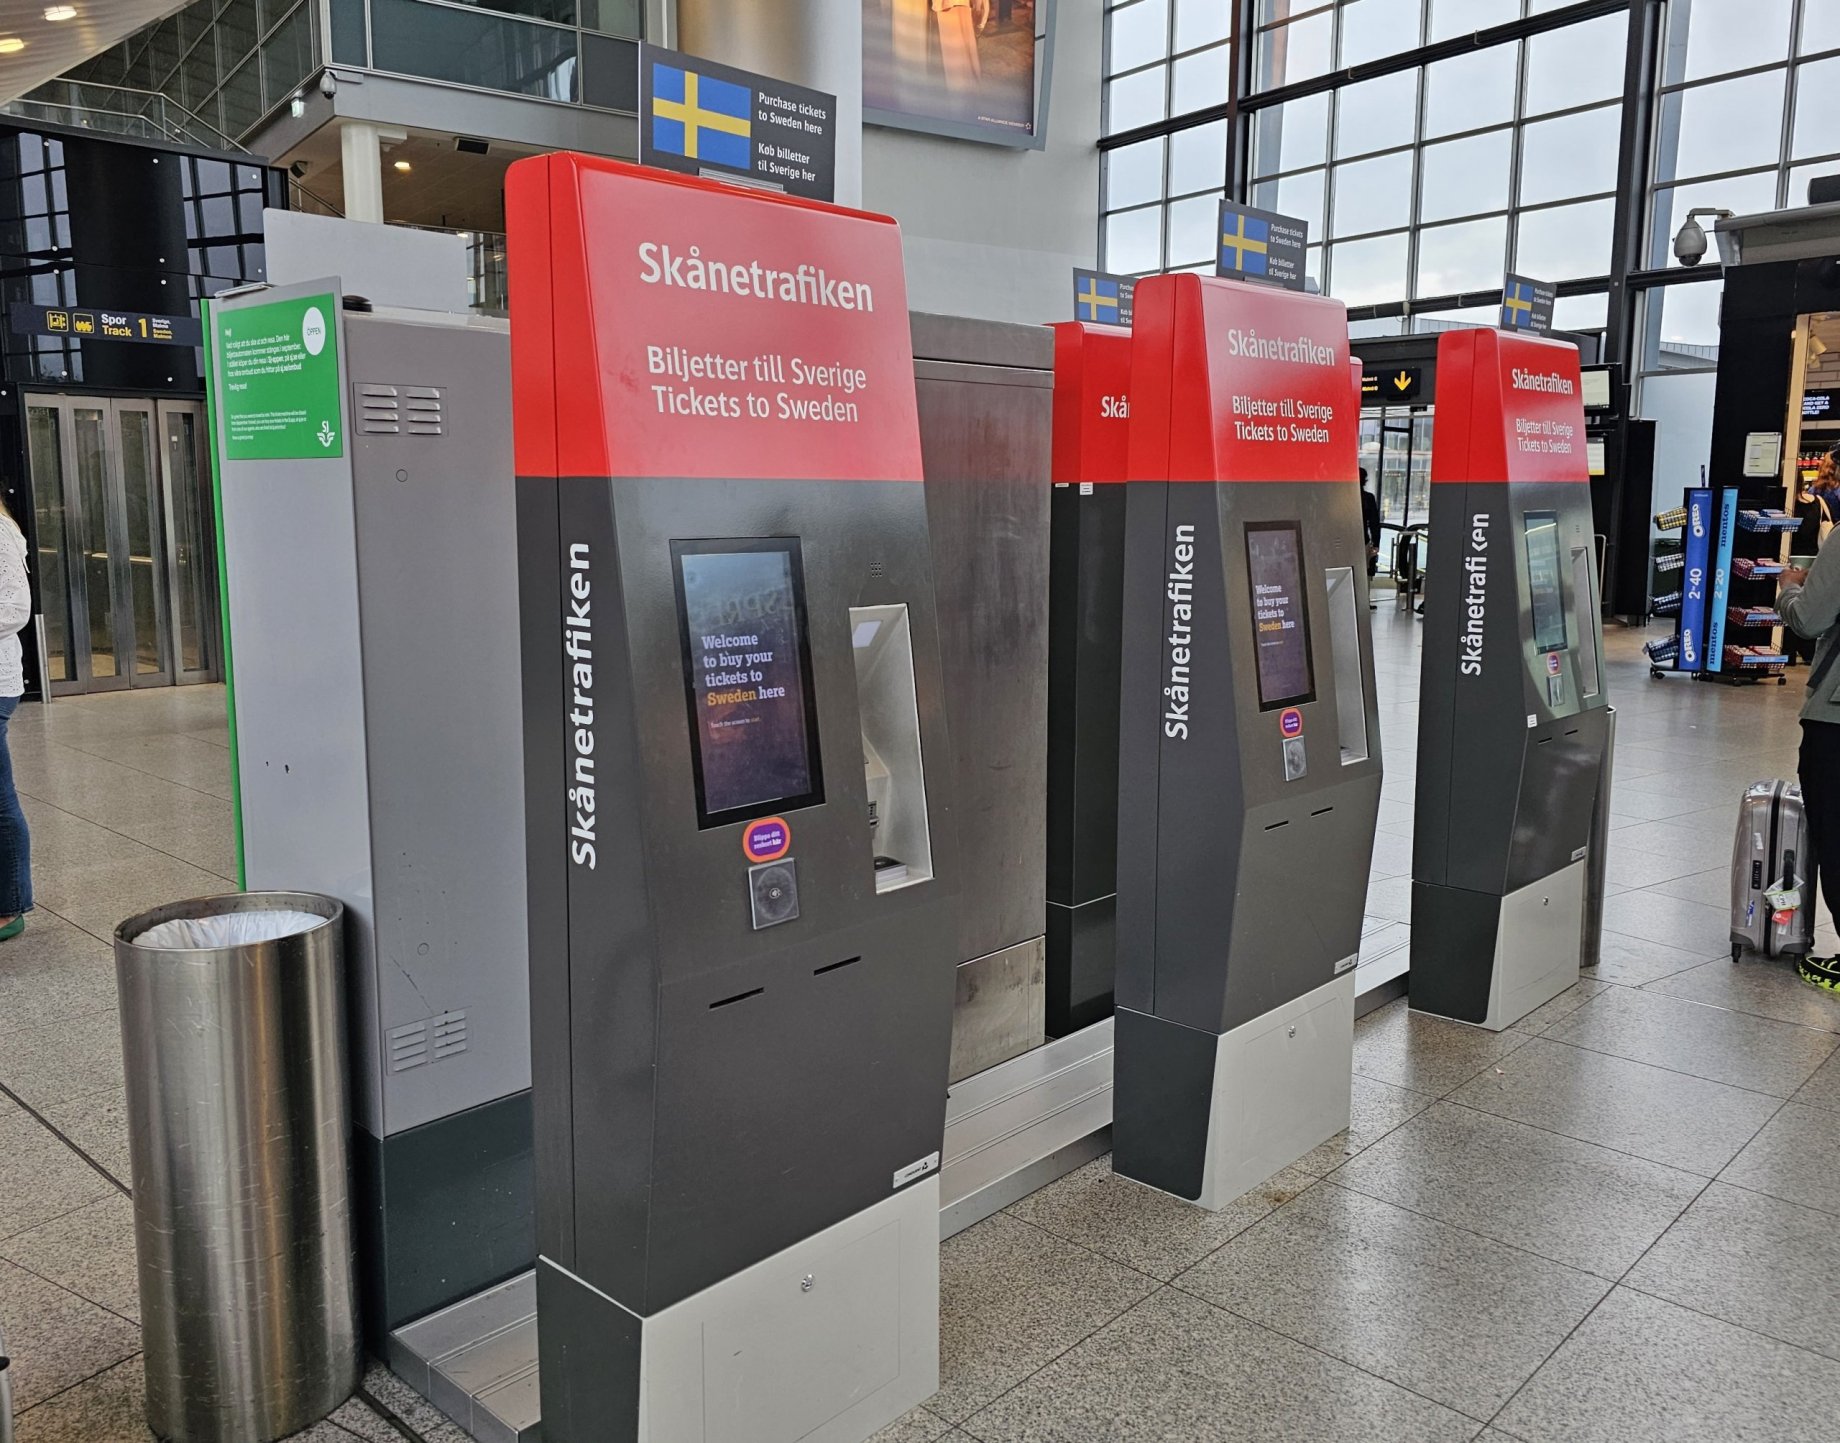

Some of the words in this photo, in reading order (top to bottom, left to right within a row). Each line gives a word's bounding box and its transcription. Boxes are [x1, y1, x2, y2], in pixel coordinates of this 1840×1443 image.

[759, 92, 796, 111] Purchase
[799, 104, 826, 119] tickets
[758, 110, 767, 120] to
[770, 112, 802, 130] Sweden
[805, 120, 822, 134] here
[759, 142, 774, 156] Køb
[777, 146, 810, 164] billetter
[758, 160, 767, 171] til
[770, 162, 800, 179] Sverige
[802, 169, 816, 181] her
[638, 242, 873, 312] Skånetrafiken
[101, 314, 126, 325] Spor
[138, 318, 148, 338] 1
[102, 326, 132, 337] Track
[1228, 328, 1335, 366] Skånetrafiken
[647, 345, 748, 382] Biljetter
[753, 354, 785, 383] till
[791, 358, 867, 393] Sverige
[1512, 368, 1573, 395] Skånetrafiken
[652, 385, 740, 418] Tickets
[747, 392, 769, 418] to
[777, 392, 858, 422] Sweden
[1100, 395, 1130, 418] Skå
[1232, 396, 1277, 419] Biljetter
[1280, 398, 1294, 418] till
[1297, 400, 1333, 423] Sverige
[1234, 421, 1274, 441] Tickets
[1277, 424, 1288, 441] to
[1290, 423, 1329, 443] Sweden
[1516, 418, 1541, 436] Biljetter
[1542, 420, 1552, 435] till
[1552, 421, 1573, 439] Sverige
[1518, 437, 1540, 452] Tickets
[1541, 440, 1547, 452] to
[1549, 440, 1572, 454] Sweden
[1692, 503, 1704, 538] OREO
[1721, 503, 1730, 547] mentos
[1256, 584, 1282, 594] Welcome
[1257, 598, 1263, 607] to
[1264, 597, 1274, 607] buy
[1276, 596, 1288, 607] your
[1258, 609, 1277, 619] tickets
[1278, 609, 1284, 618] to
[1259, 622, 1281, 632] Sweden
[1282, 619, 1295, 629] here
[701, 634, 758, 650] Welcome
[1164, 524, 1194, 740] Skånetrafiken
[1709, 622, 1718, 665] mentos
[1683, 628, 1696, 662] OREO
[703, 656, 717, 668] to
[719, 654, 742, 667] buy
[745, 652, 773, 666] your
[705, 671, 748, 687] tickets
[750, 670, 763, 682] to
[566, 543, 596, 870] Skånetrafiken
[707, 689, 757, 706] Sweden
[758, 686, 785, 699] here
